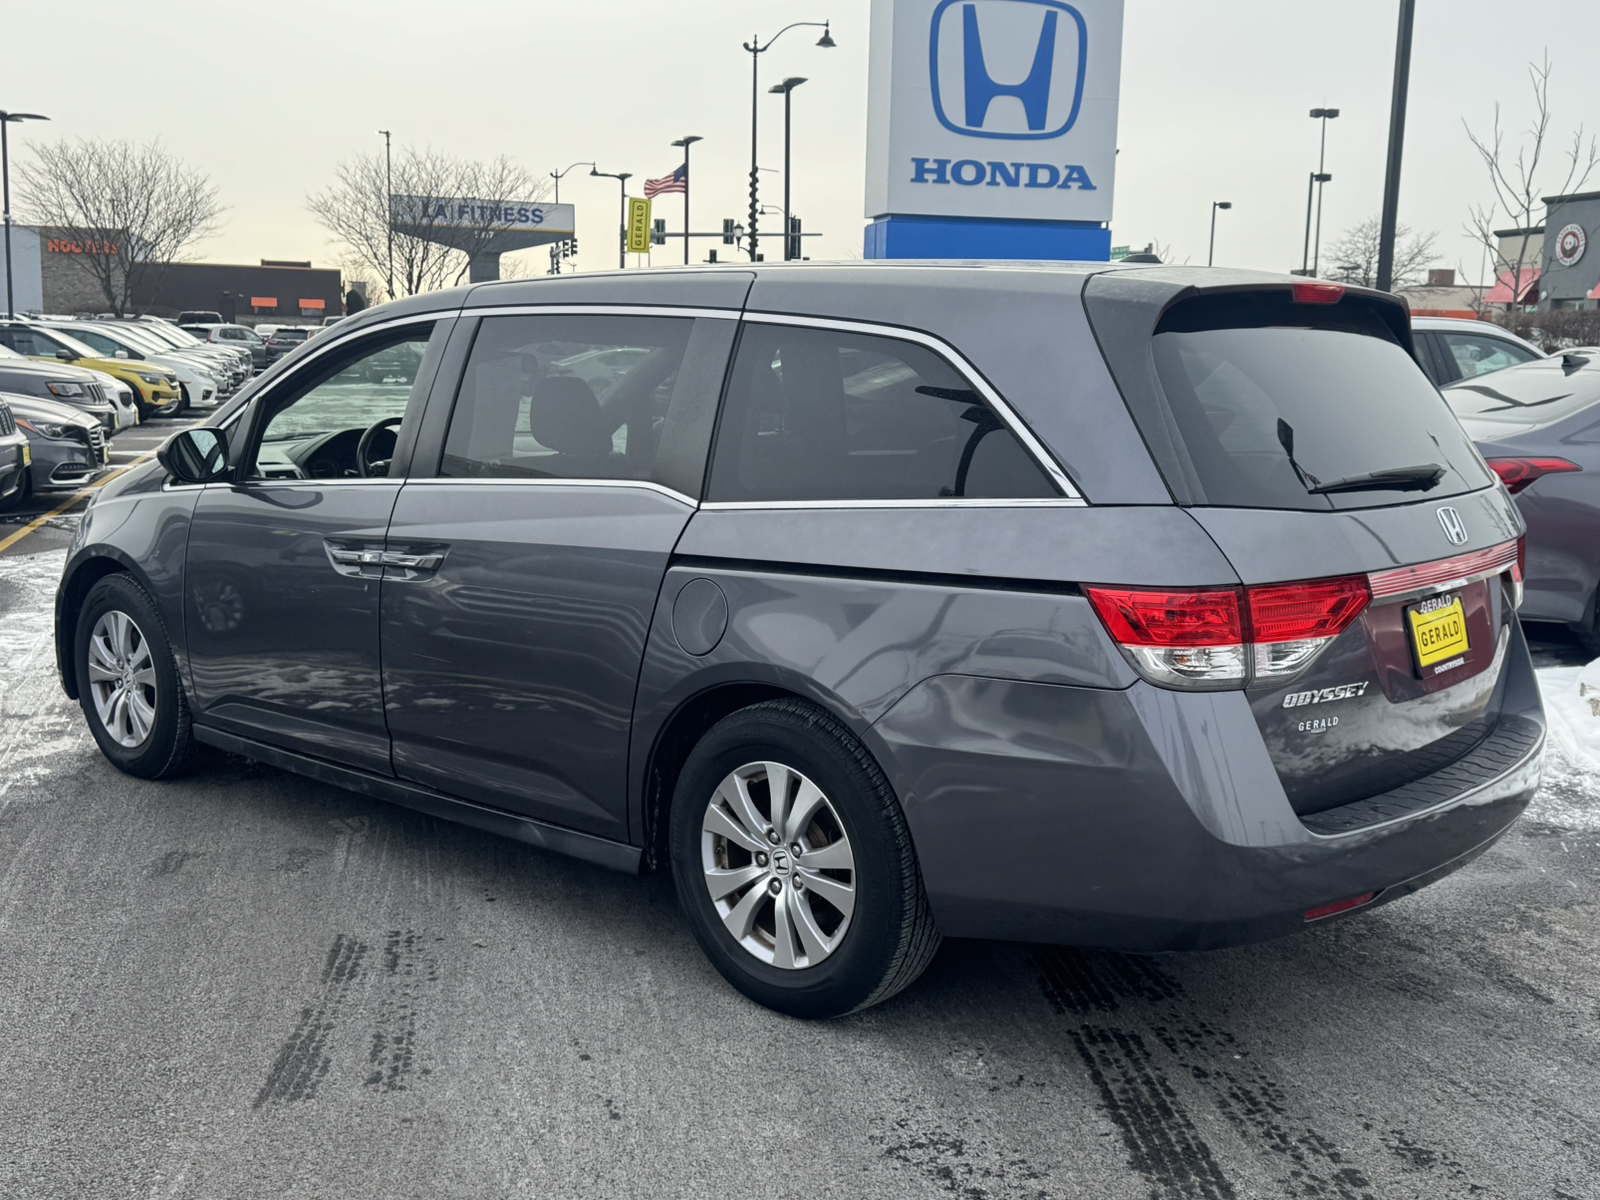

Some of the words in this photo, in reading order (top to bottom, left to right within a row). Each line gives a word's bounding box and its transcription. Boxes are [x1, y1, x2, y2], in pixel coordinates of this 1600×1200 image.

[910, 157, 1098, 190] HONDA
[457, 204, 544, 224] FITNESS
[635, 204, 645, 246] GERALD
[1420, 594, 1452, 614] GERALD
[1420, 620, 1460, 647] GERALD
[1282, 681, 1369, 708] ODYSSEY
[1298, 716, 1339, 732] GERALD
